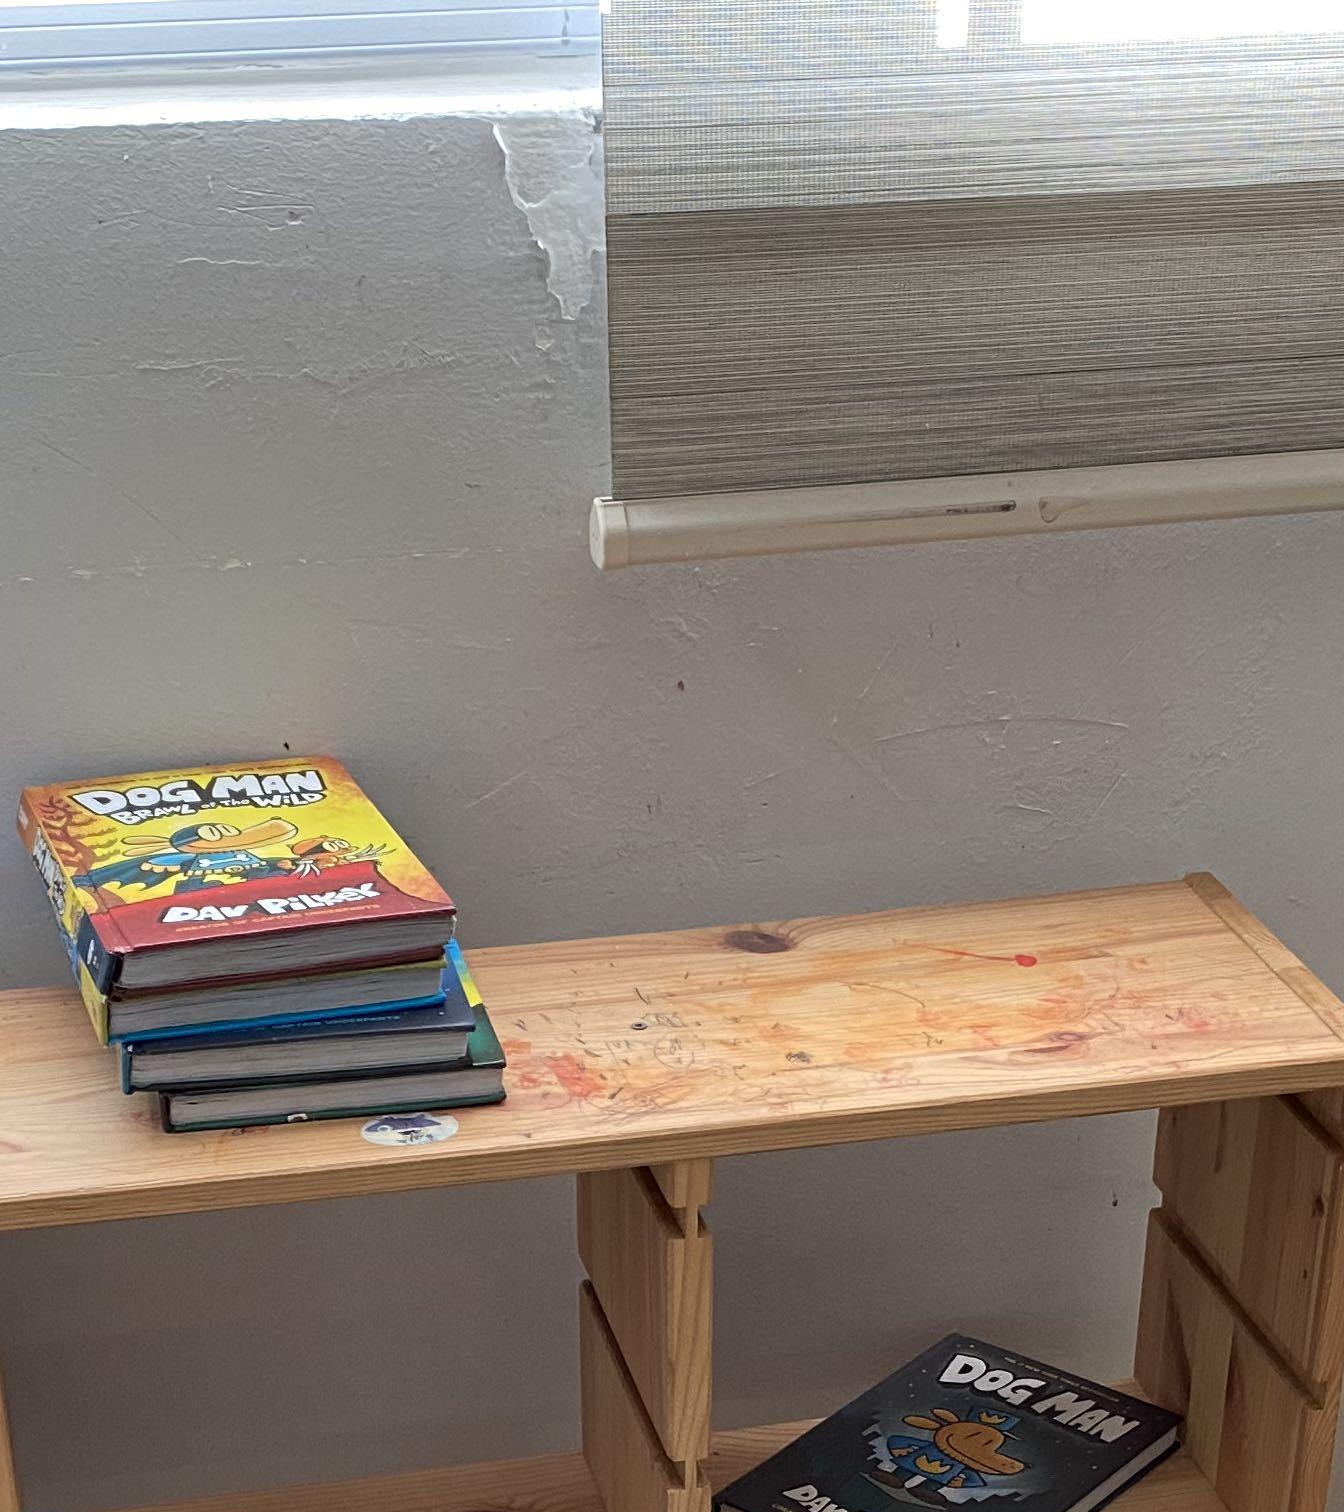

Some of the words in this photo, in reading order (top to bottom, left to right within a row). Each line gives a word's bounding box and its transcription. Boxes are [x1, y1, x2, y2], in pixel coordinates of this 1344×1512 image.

[72, 780, 201, 815] DOG
[212, 770, 324, 800] MAN
[110, 804, 196, 825] BRAWL
[162, 904, 248, 923] DAV
[939, 1354, 1047, 1406] DOG
[1031, 1391, 1141, 1444] MAN
